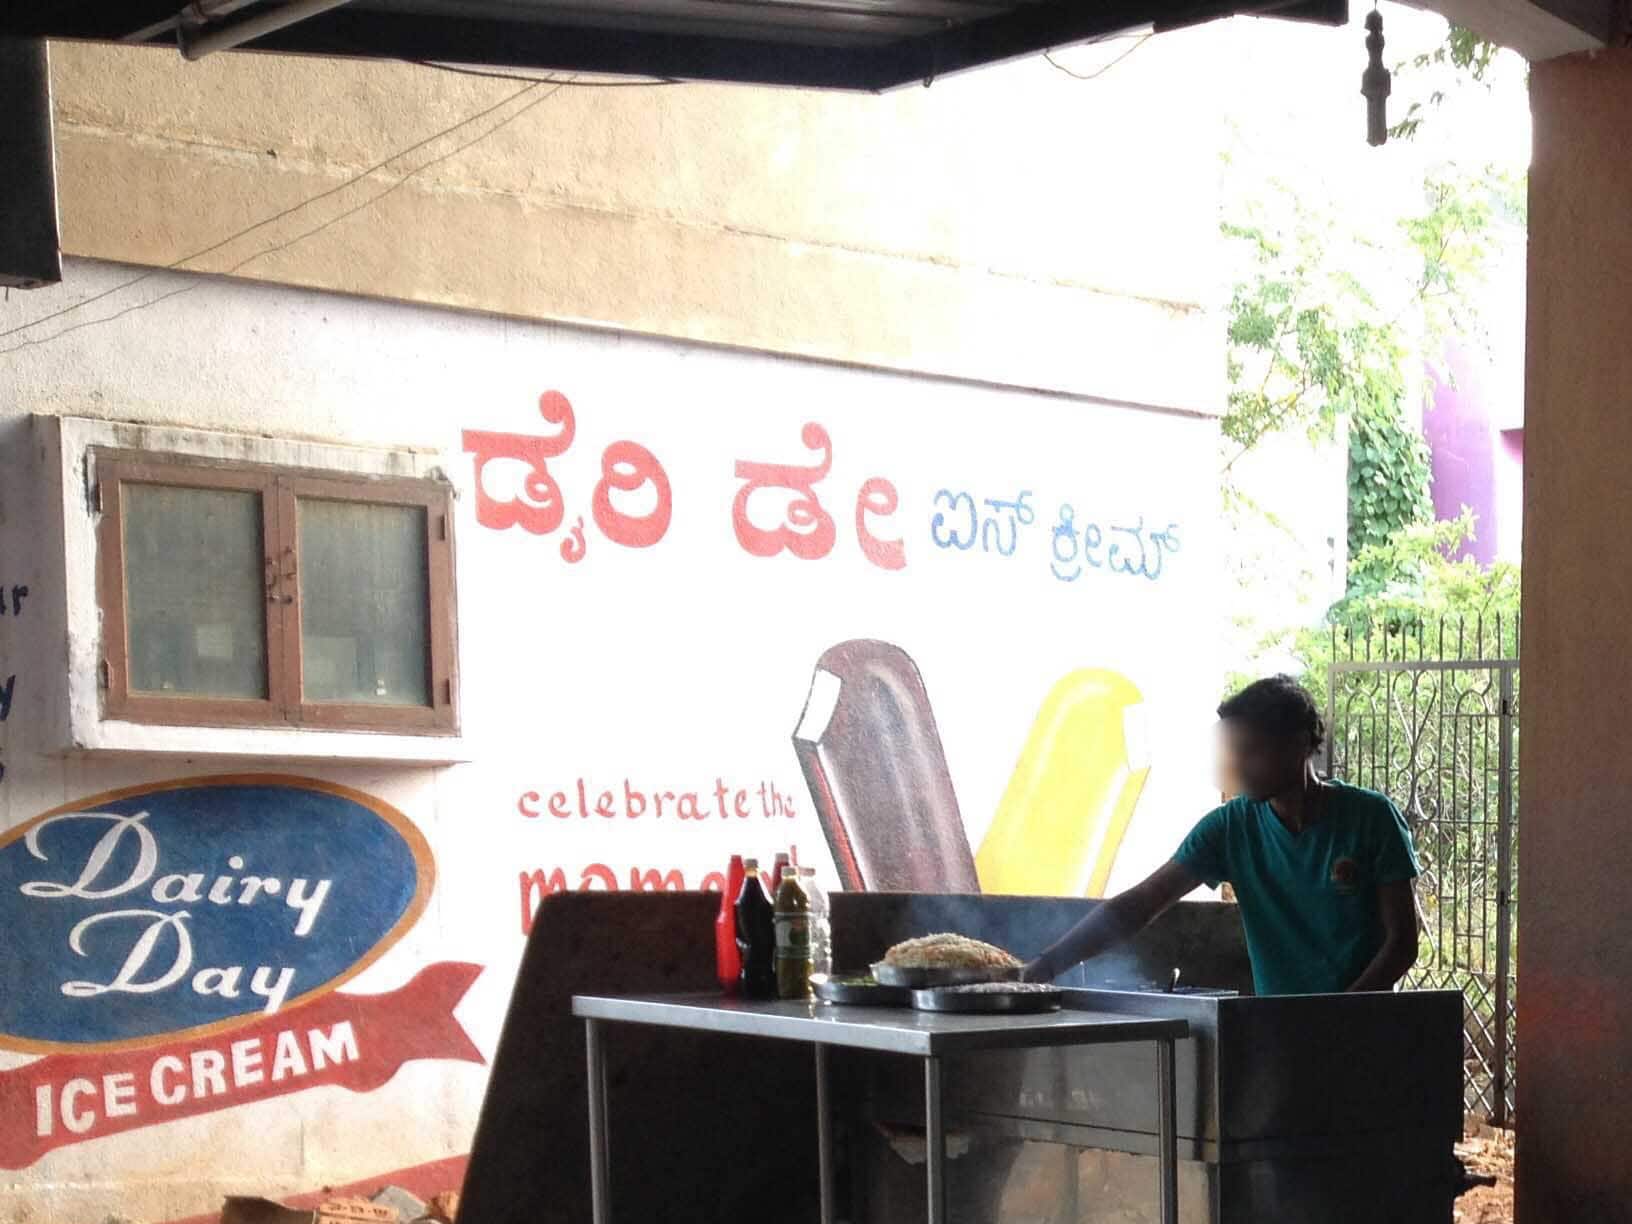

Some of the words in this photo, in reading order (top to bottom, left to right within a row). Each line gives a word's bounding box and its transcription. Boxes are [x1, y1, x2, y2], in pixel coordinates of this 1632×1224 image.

[732, 421, 907, 571] ಡೇ
[517, 777, 750, 820] celebrate
[756, 780, 797, 819] the
[20, 811, 332, 936] Dairy
[60, 909, 296, 1015] Day
[35, 1072, 138, 1137] ICE
[150, 1020, 360, 1105] CREAM
